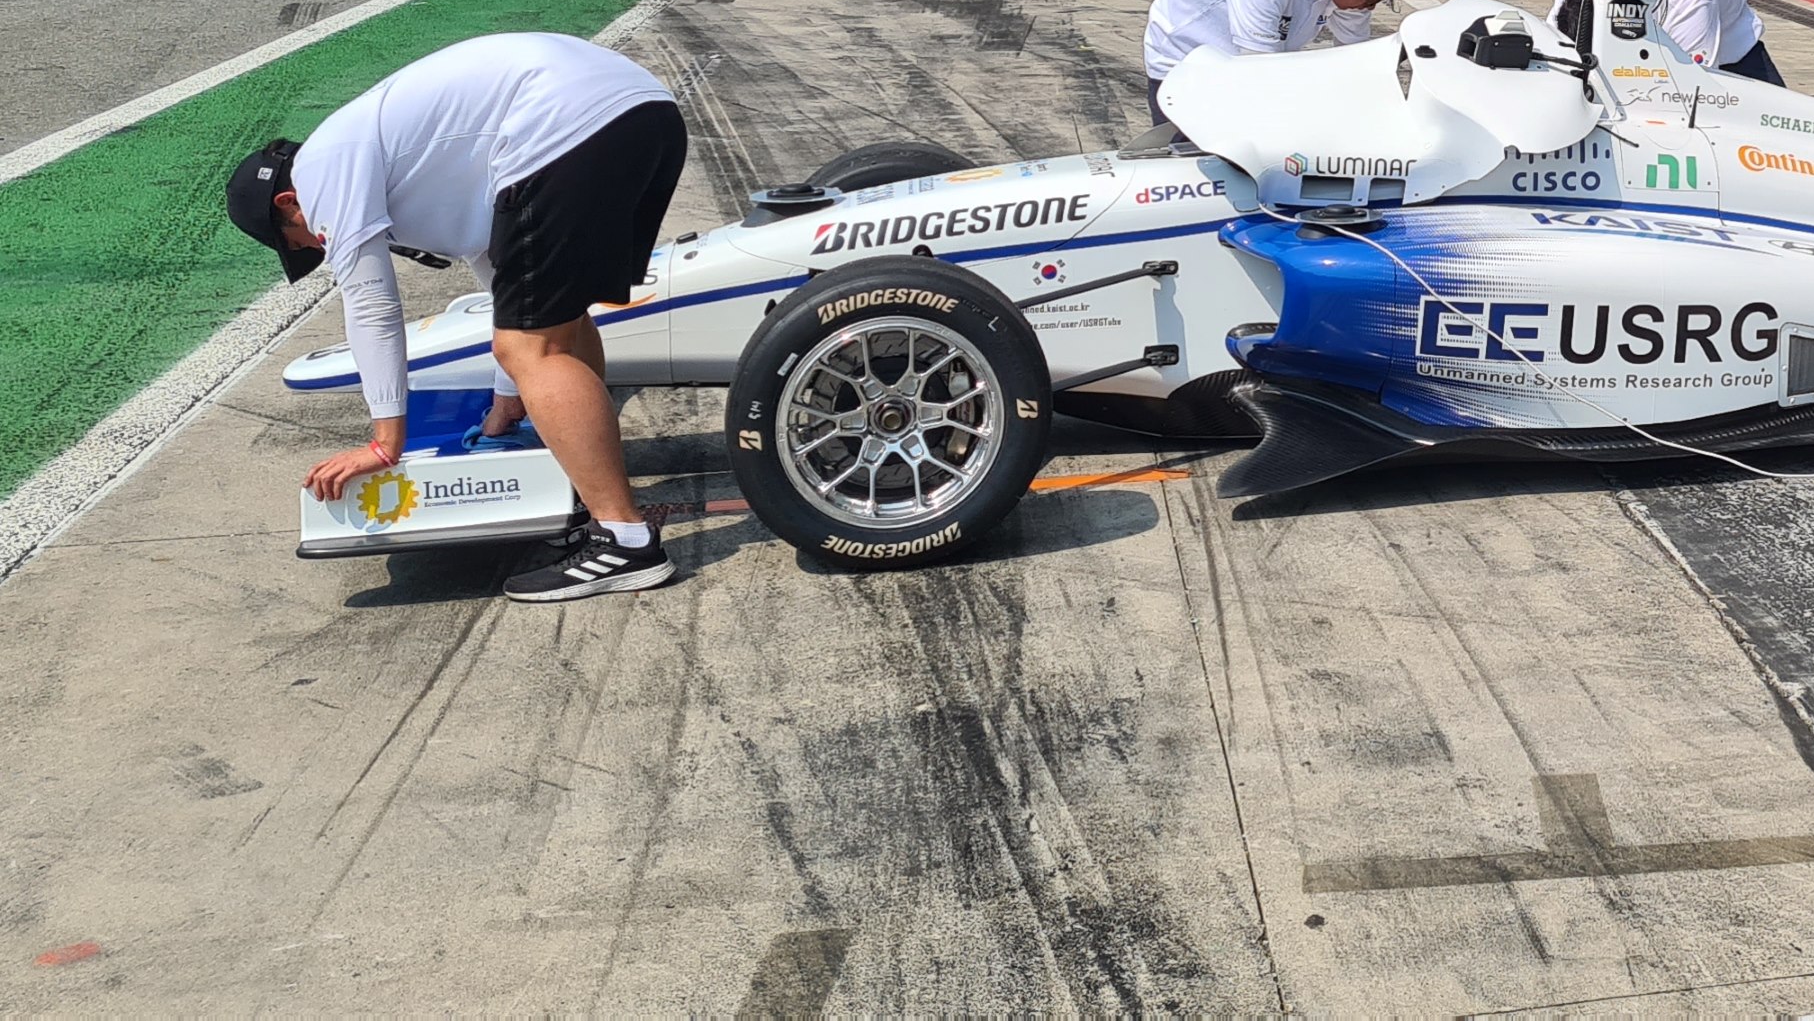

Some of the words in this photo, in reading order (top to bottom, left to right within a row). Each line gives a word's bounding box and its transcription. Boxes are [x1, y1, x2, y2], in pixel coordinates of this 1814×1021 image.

[1607, 3, 1649, 18] INDY
[1611, 66, 1669, 78] dallara
[1315, 156, 1418, 177] LUMINAR
[1135, 180, 1227, 204] dSPACE
[1512, 170, 1601, 192] CISCO
[810, 193, 1091, 256] BRIDGESTONE
[1530, 213, 1739, 243] KAIST
[817, 287, 959, 325] BRIDGESTONE
[1023, 302, 1090, 314] ned.kaist.ac.kr
[1033, 317, 1122, 330] e.com/user/USRGTube
[1559, 301, 1780, 365] USRG
[1419, 364, 1526, 386] Unmanned
[1533, 372, 1617, 389] Systems
[1625, 374, 1713, 389] Research
[1720, 370, 1774, 389] Group
[422, 476, 521, 500] Indiana
[424, 499, 458, 508] Economic
[458, 495, 503, 505] Development
[504, 494, 521, 502] Corp
[820, 521, 962, 560] BRIDGESTONE
